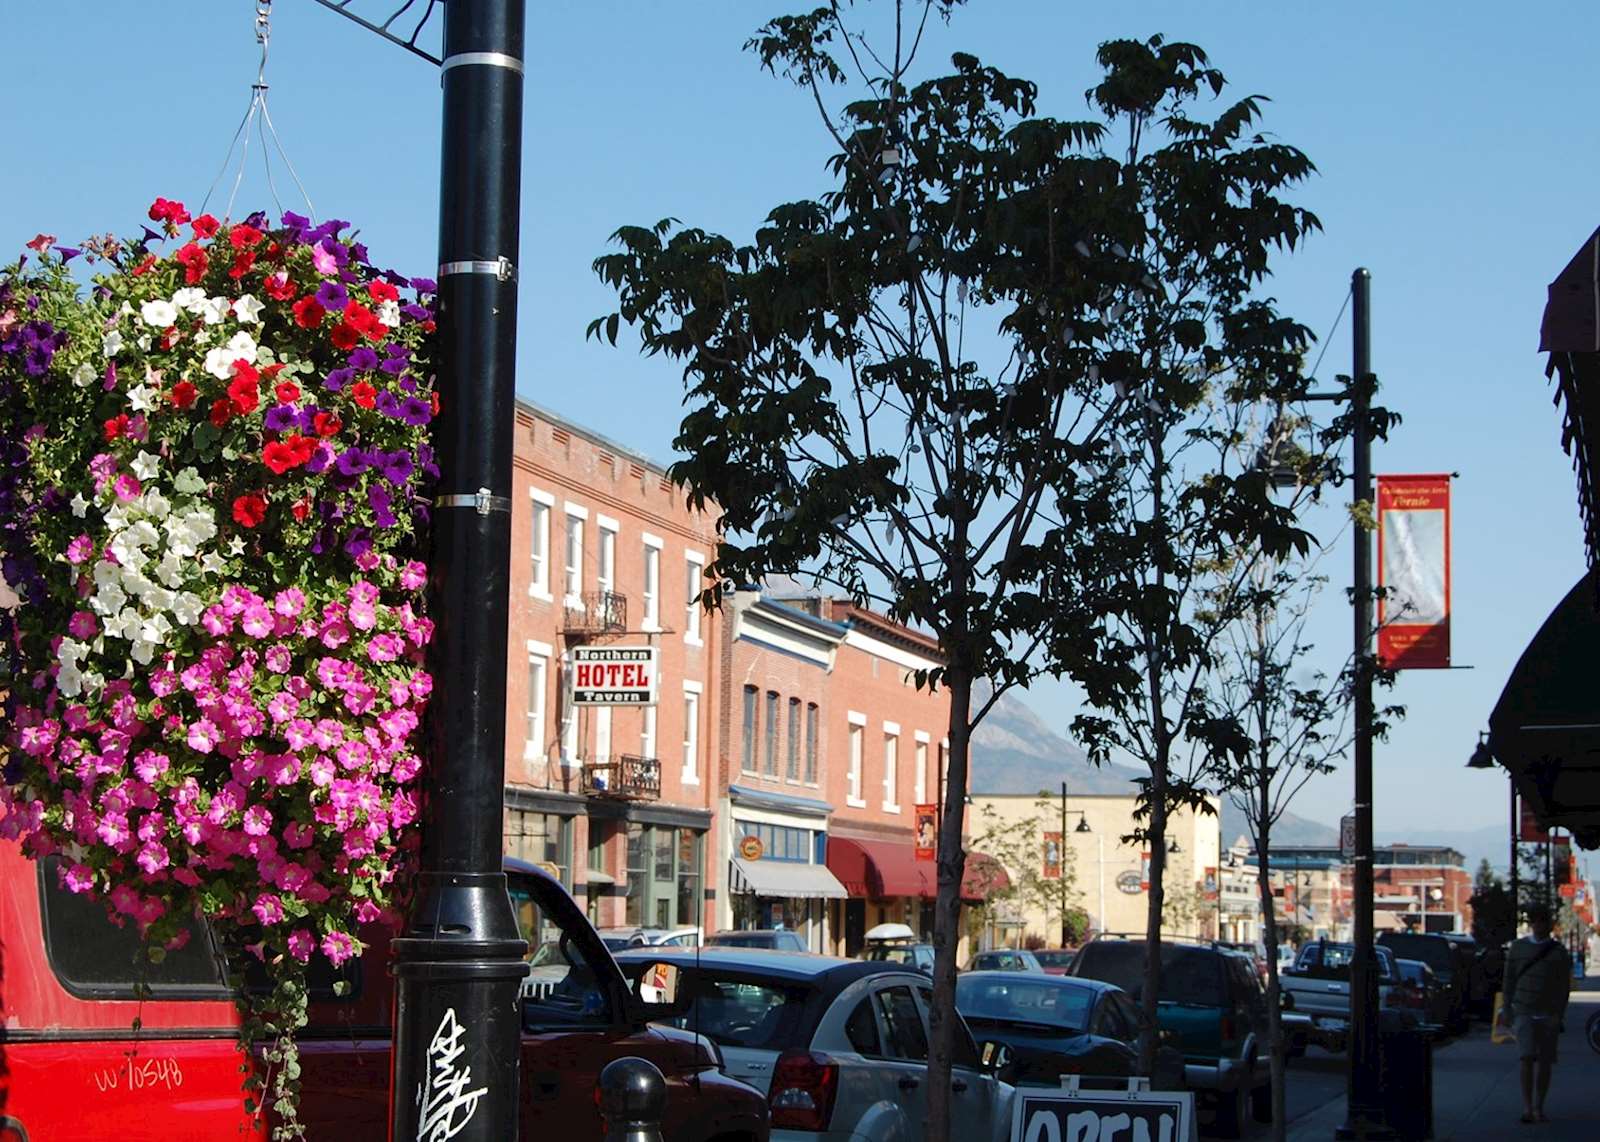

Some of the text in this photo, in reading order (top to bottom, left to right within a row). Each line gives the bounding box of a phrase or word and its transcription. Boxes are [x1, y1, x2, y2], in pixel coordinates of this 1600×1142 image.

[579, 650, 648, 660] Northern
[576, 664, 649, 687] HOTEL
[583, 691, 640, 701] Tavern
